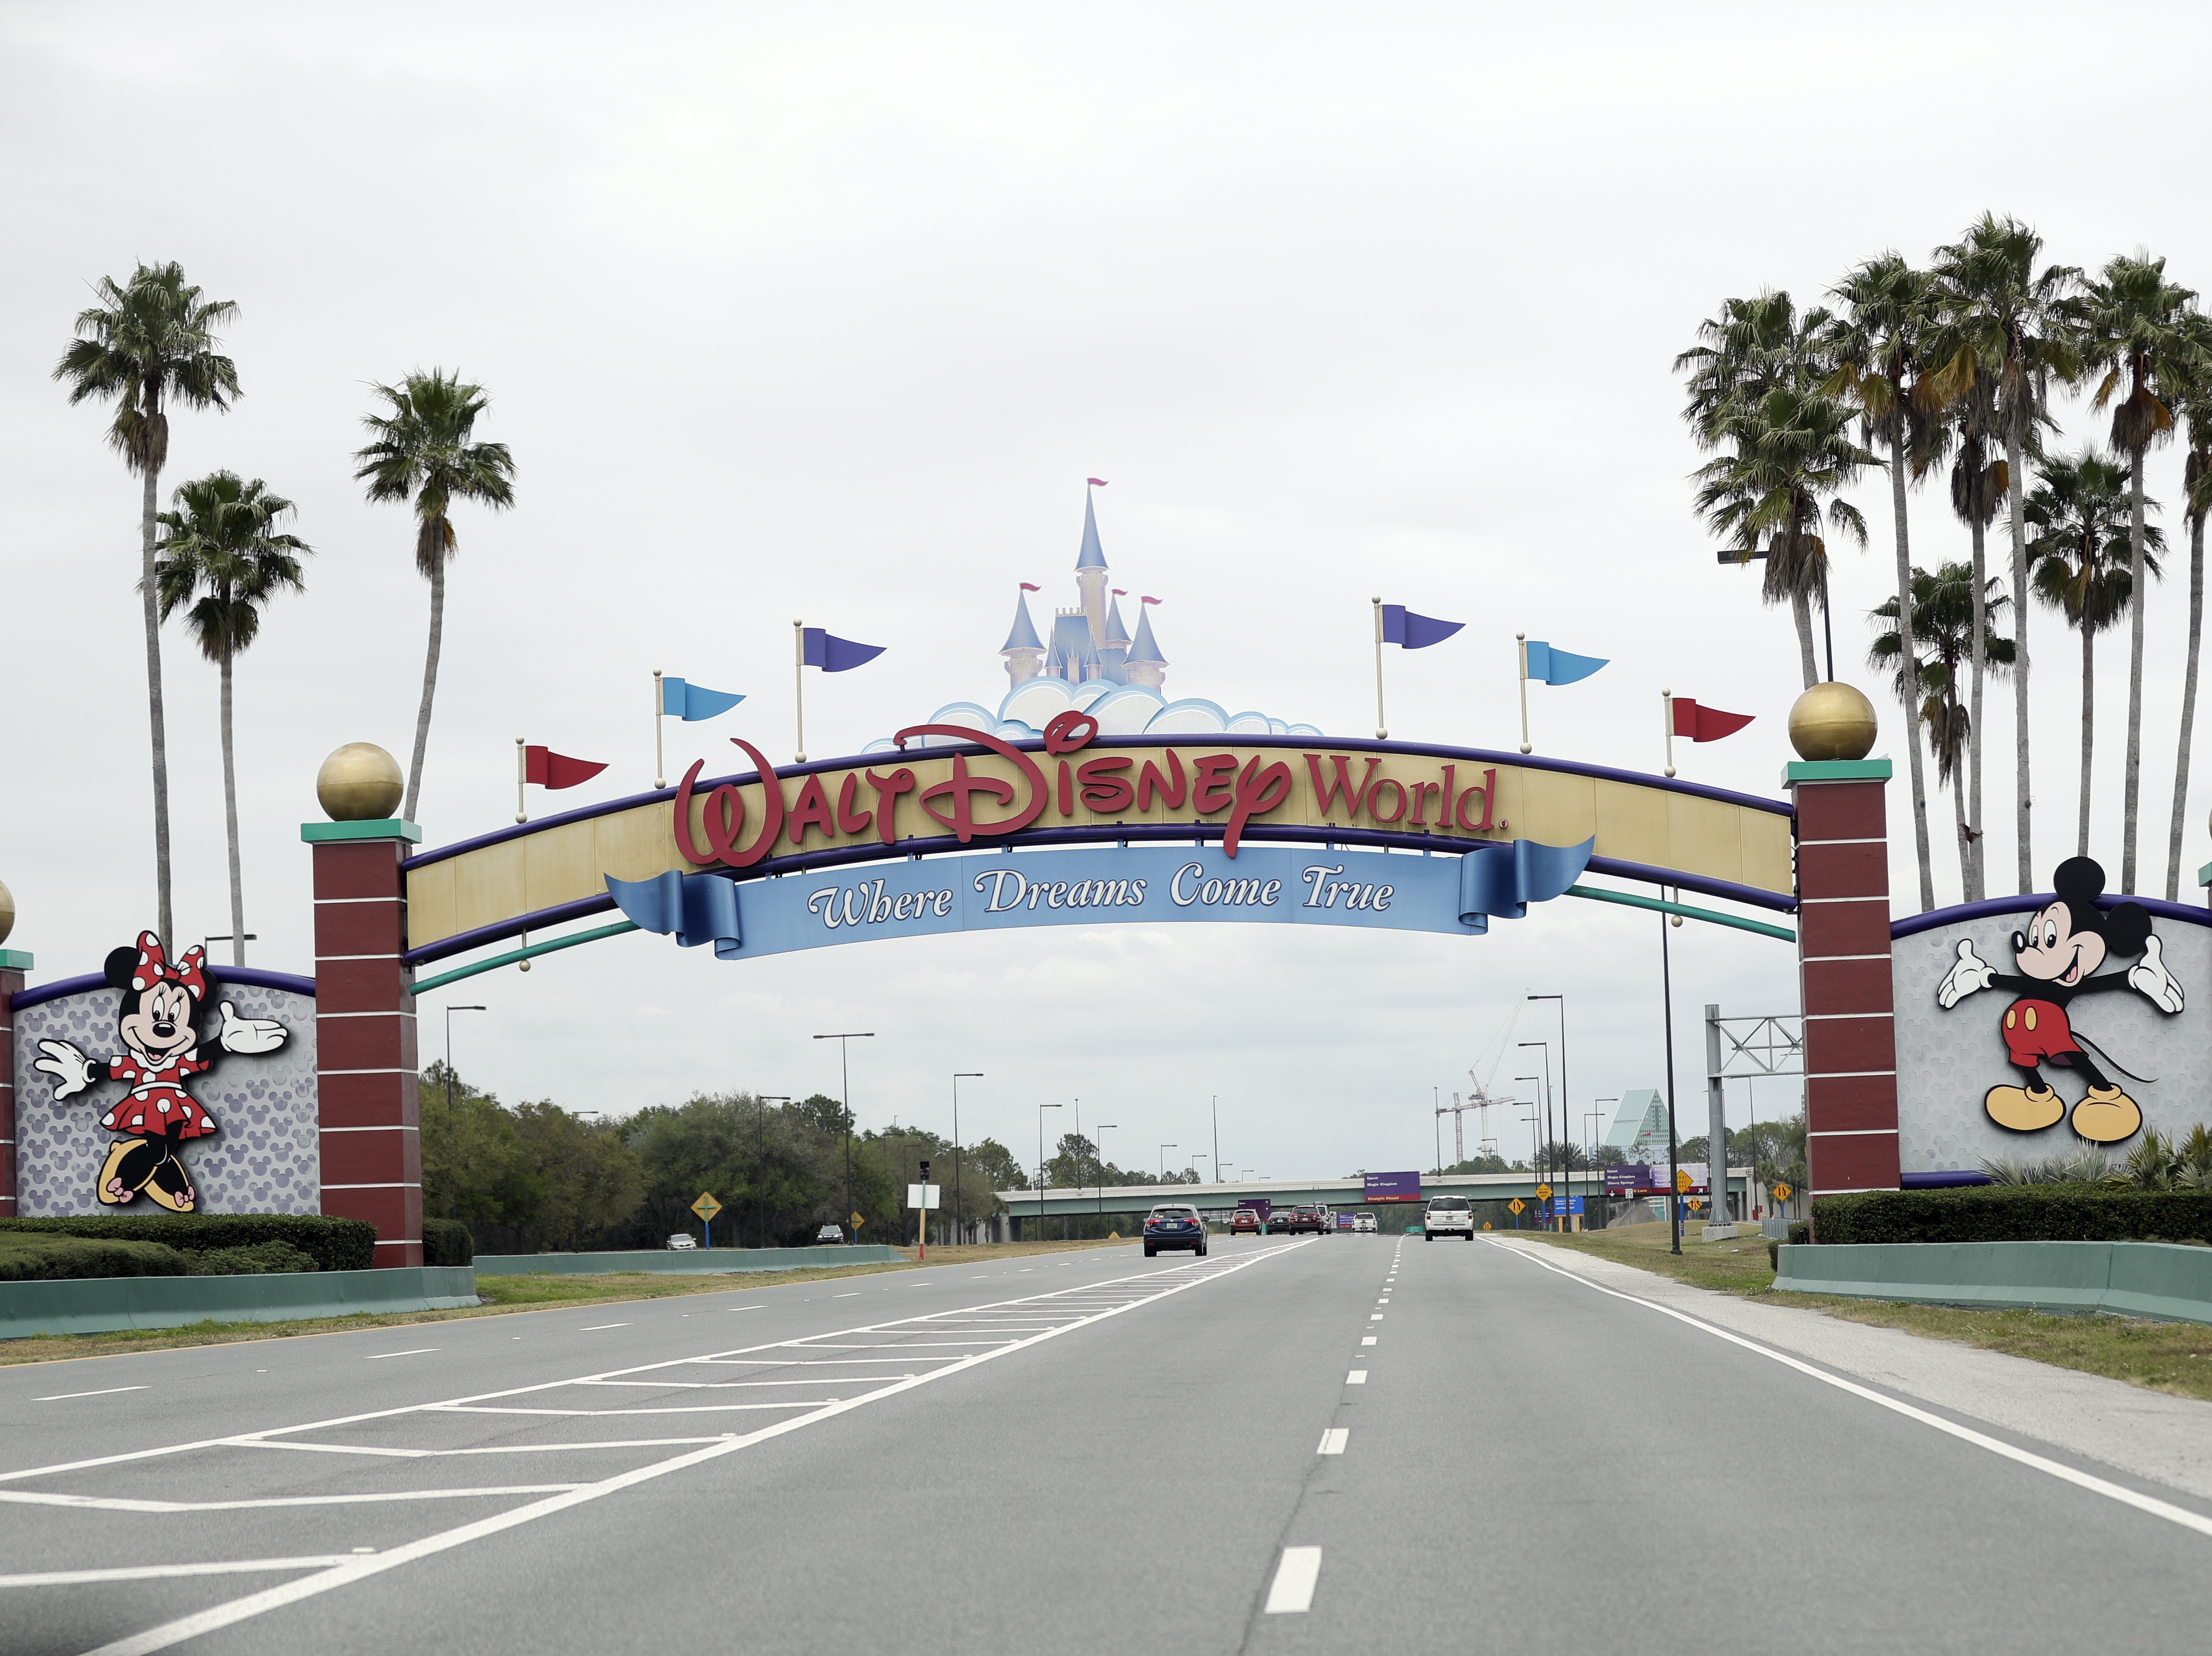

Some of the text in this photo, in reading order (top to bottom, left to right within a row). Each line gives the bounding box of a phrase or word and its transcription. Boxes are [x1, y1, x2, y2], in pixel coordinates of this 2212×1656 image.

[808, 861, 1395, 929] Where Dreams Come True
